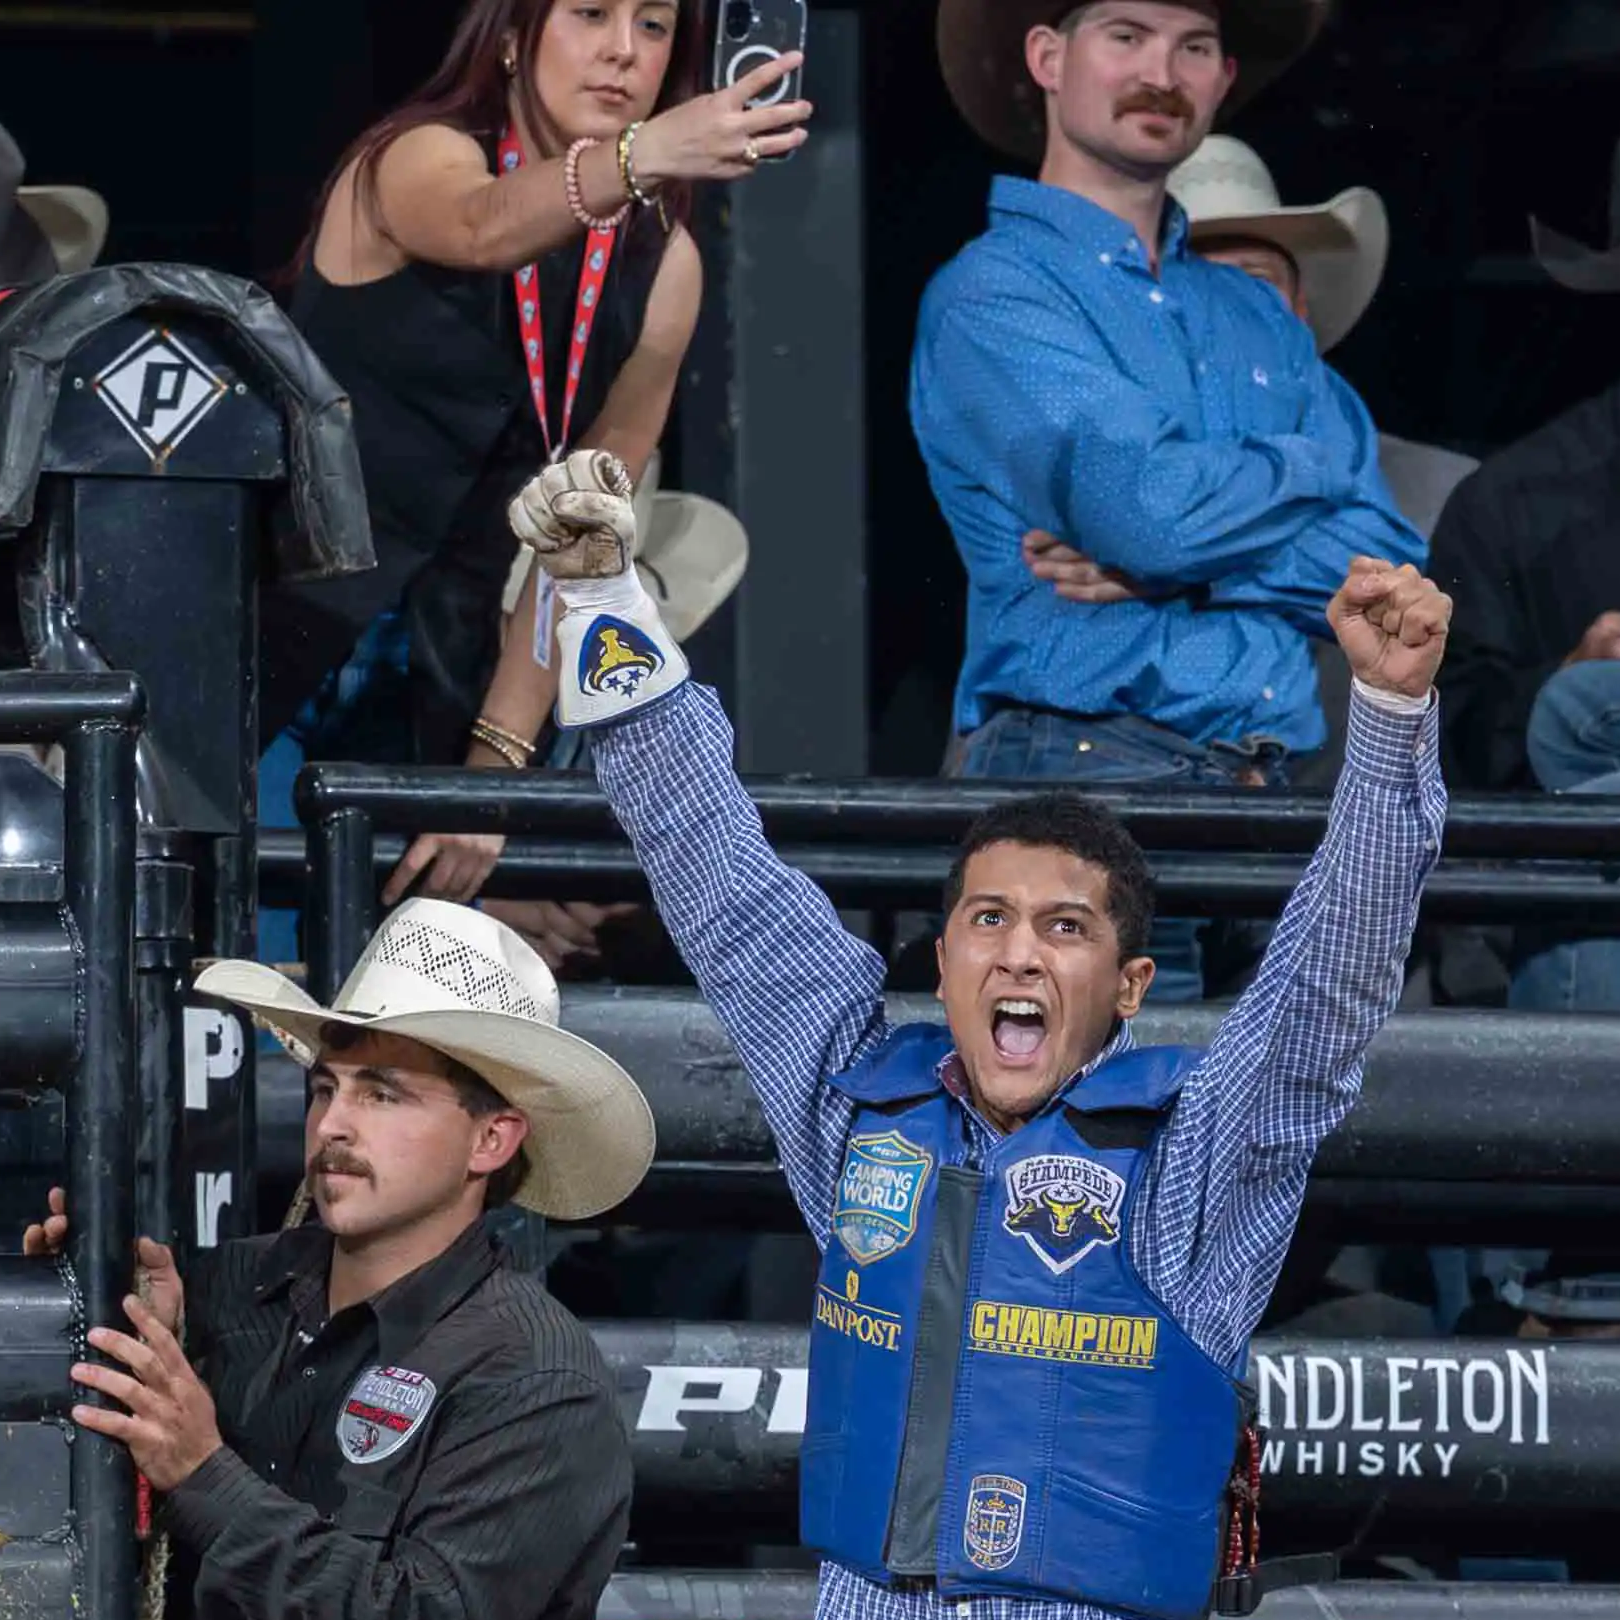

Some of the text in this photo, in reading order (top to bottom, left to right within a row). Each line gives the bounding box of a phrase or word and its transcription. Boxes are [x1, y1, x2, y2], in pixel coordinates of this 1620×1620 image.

[846, 1161, 914, 1191] CAMPING
[1020, 1163, 1113, 1198] STAMPEDE
[1026, 1157, 1109, 1177] NASHVILLE
[844, 1179, 909, 1212] WORLD
[974, 1302, 1154, 1358] CHAMPION
[1259, 1441, 1460, 1476] WHISKY
